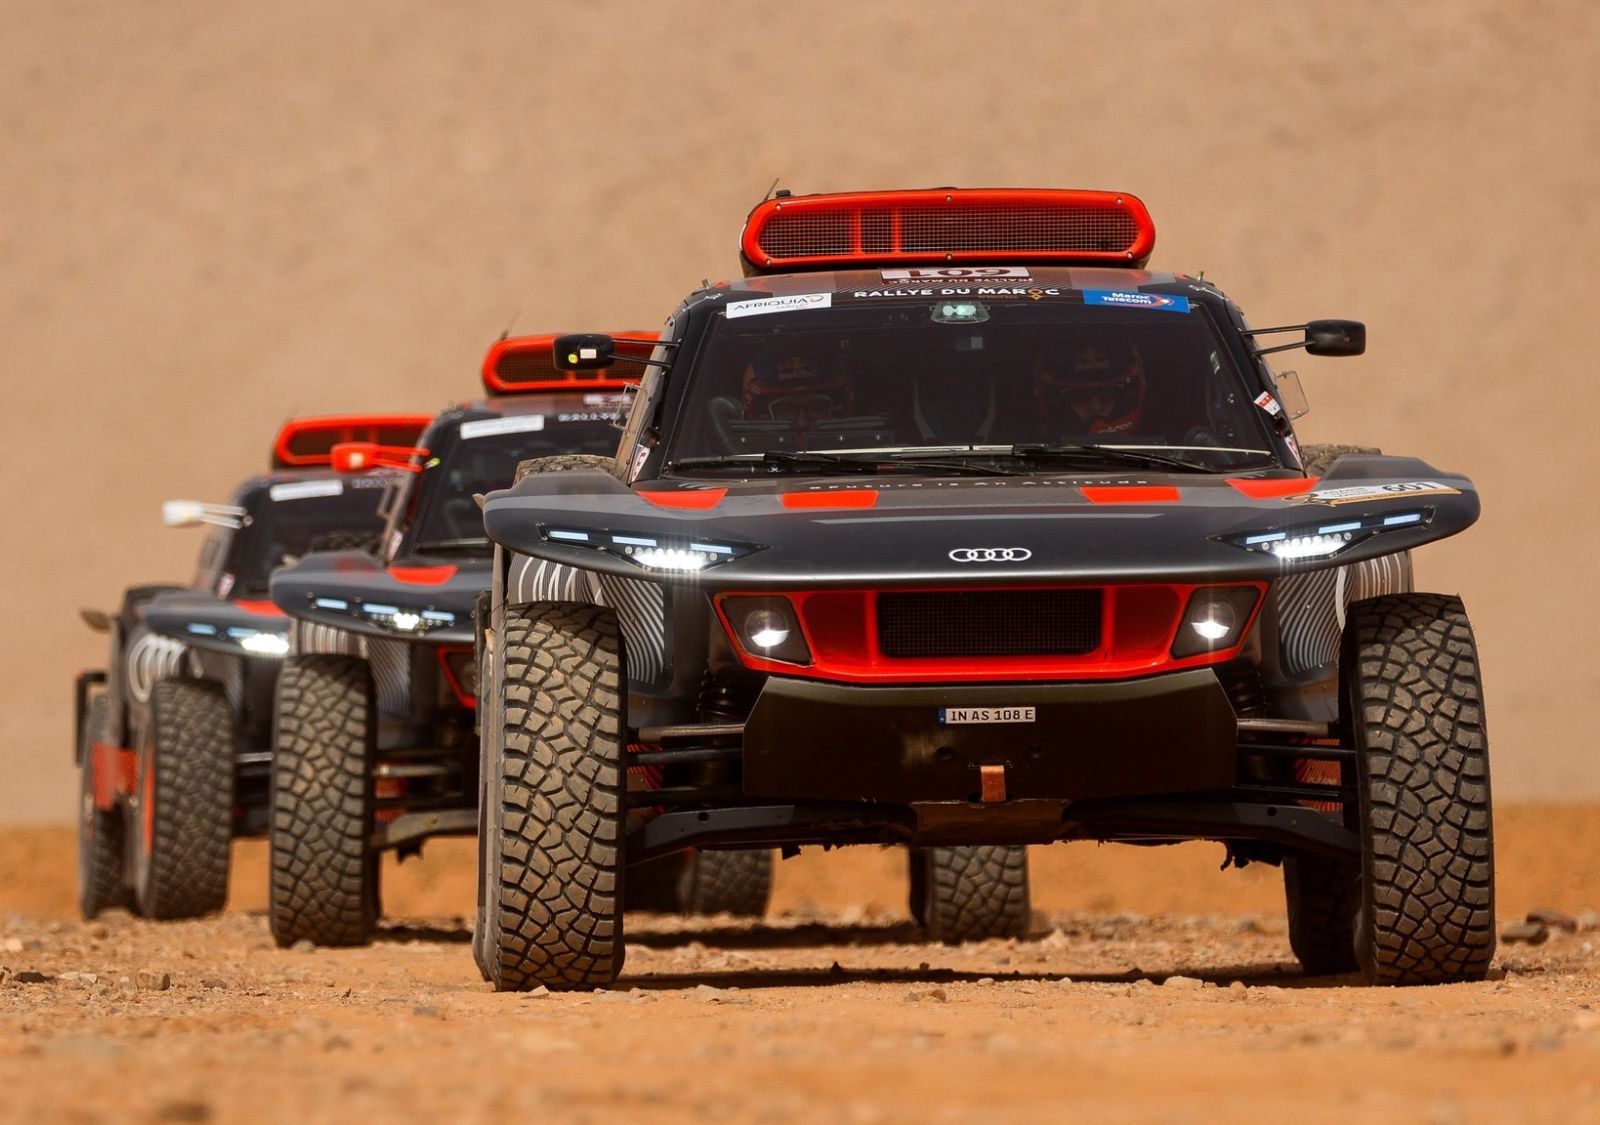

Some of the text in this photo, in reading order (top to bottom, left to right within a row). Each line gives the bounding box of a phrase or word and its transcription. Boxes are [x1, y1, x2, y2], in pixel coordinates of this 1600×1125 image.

[854, 288, 933, 298] RALLYE
[977, 287, 1061, 299] MAROC
[1111, 292, 1151, 300] Maroc
[734, 298, 808, 311] AFRIQUIA
[1101, 296, 1152, 305] Telecom
[1382, 481, 1438, 492] 601
[951, 709, 1034, 721] IN AS 108 E
